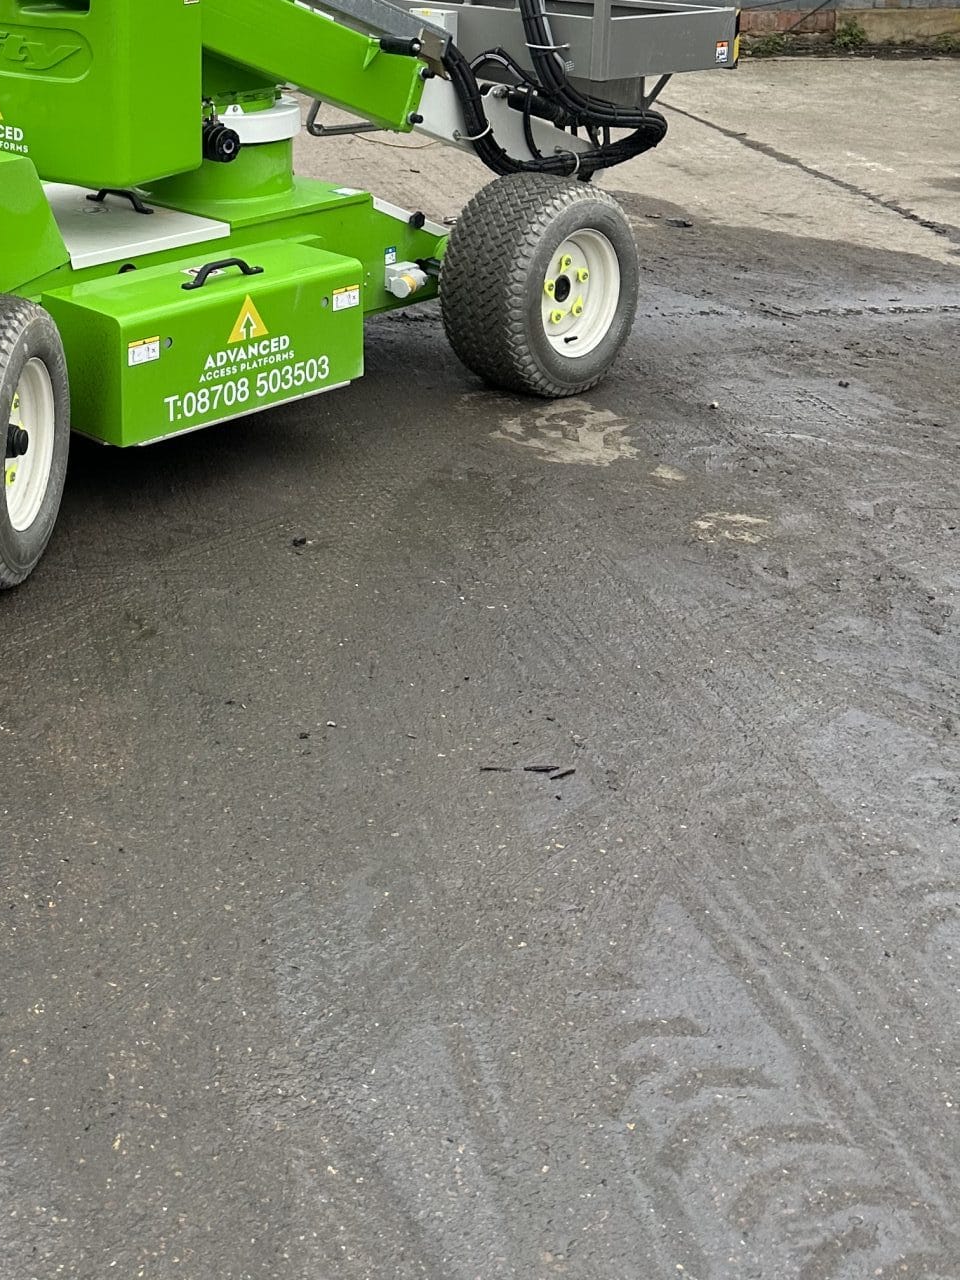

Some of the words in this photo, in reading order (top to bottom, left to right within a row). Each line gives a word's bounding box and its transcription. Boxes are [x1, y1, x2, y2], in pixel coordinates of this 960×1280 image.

[199, 365, 238, 383] ACCESS
[240, 350, 295, 372] PLATFORMS
[203, 335, 290, 371] ADVANCED
[163, 380, 250, 422] T:08708
[255, 355, 330, 398] 503503
